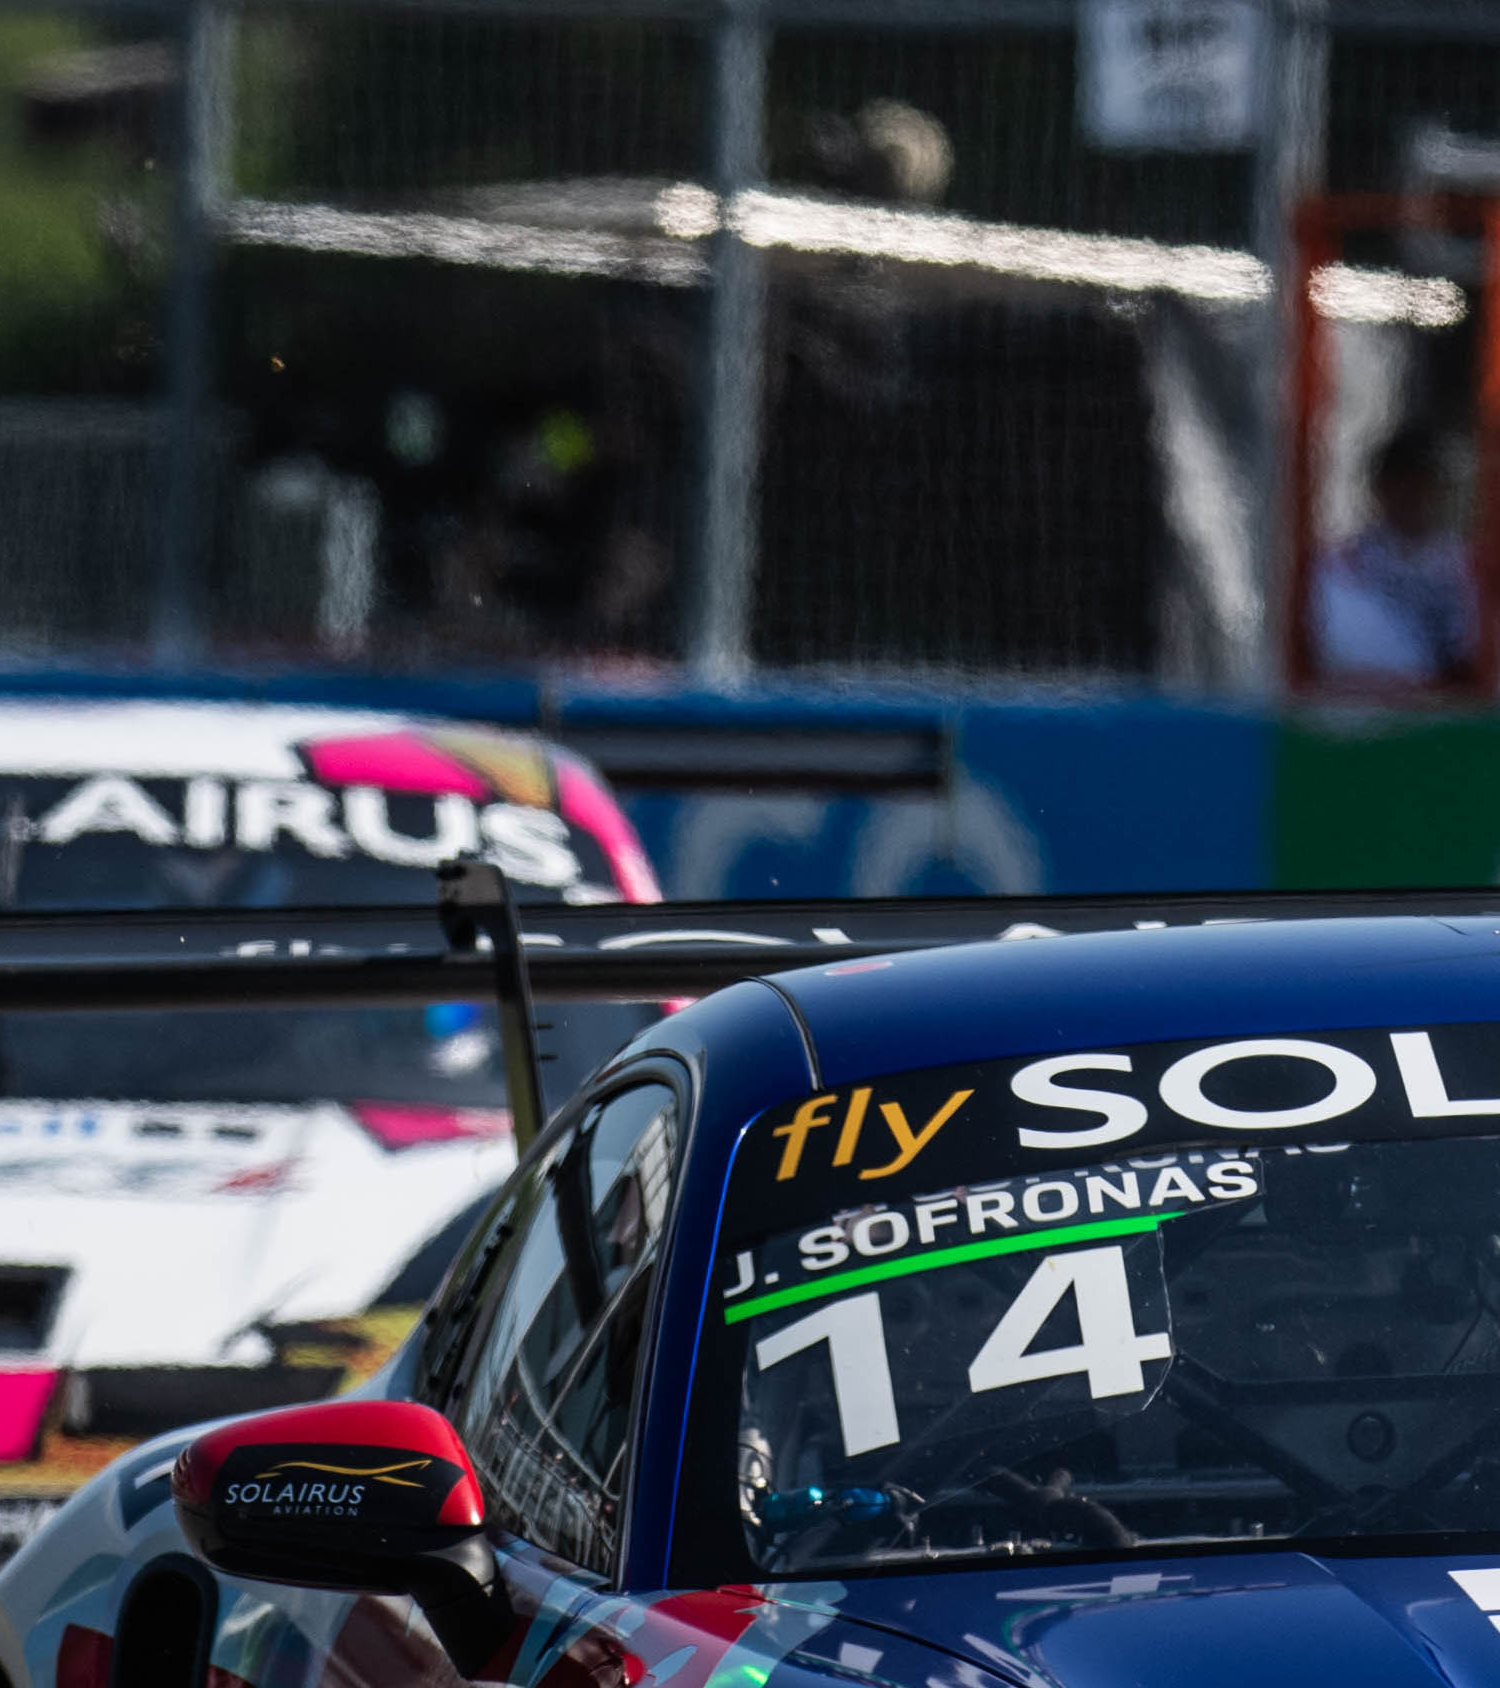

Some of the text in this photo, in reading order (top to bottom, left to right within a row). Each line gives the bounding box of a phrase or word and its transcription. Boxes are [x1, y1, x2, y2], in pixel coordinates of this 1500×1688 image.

[772, 1087, 975, 1182] fly
[723, 1251, 780, 1299] J.
[799, 1160, 1259, 1272] SOFRONAS
[755, 1245, 1172, 1458] 14
[225, 1483, 366, 1505] SOLAIRUS
[272, 1504, 360, 1517] AVIATION
